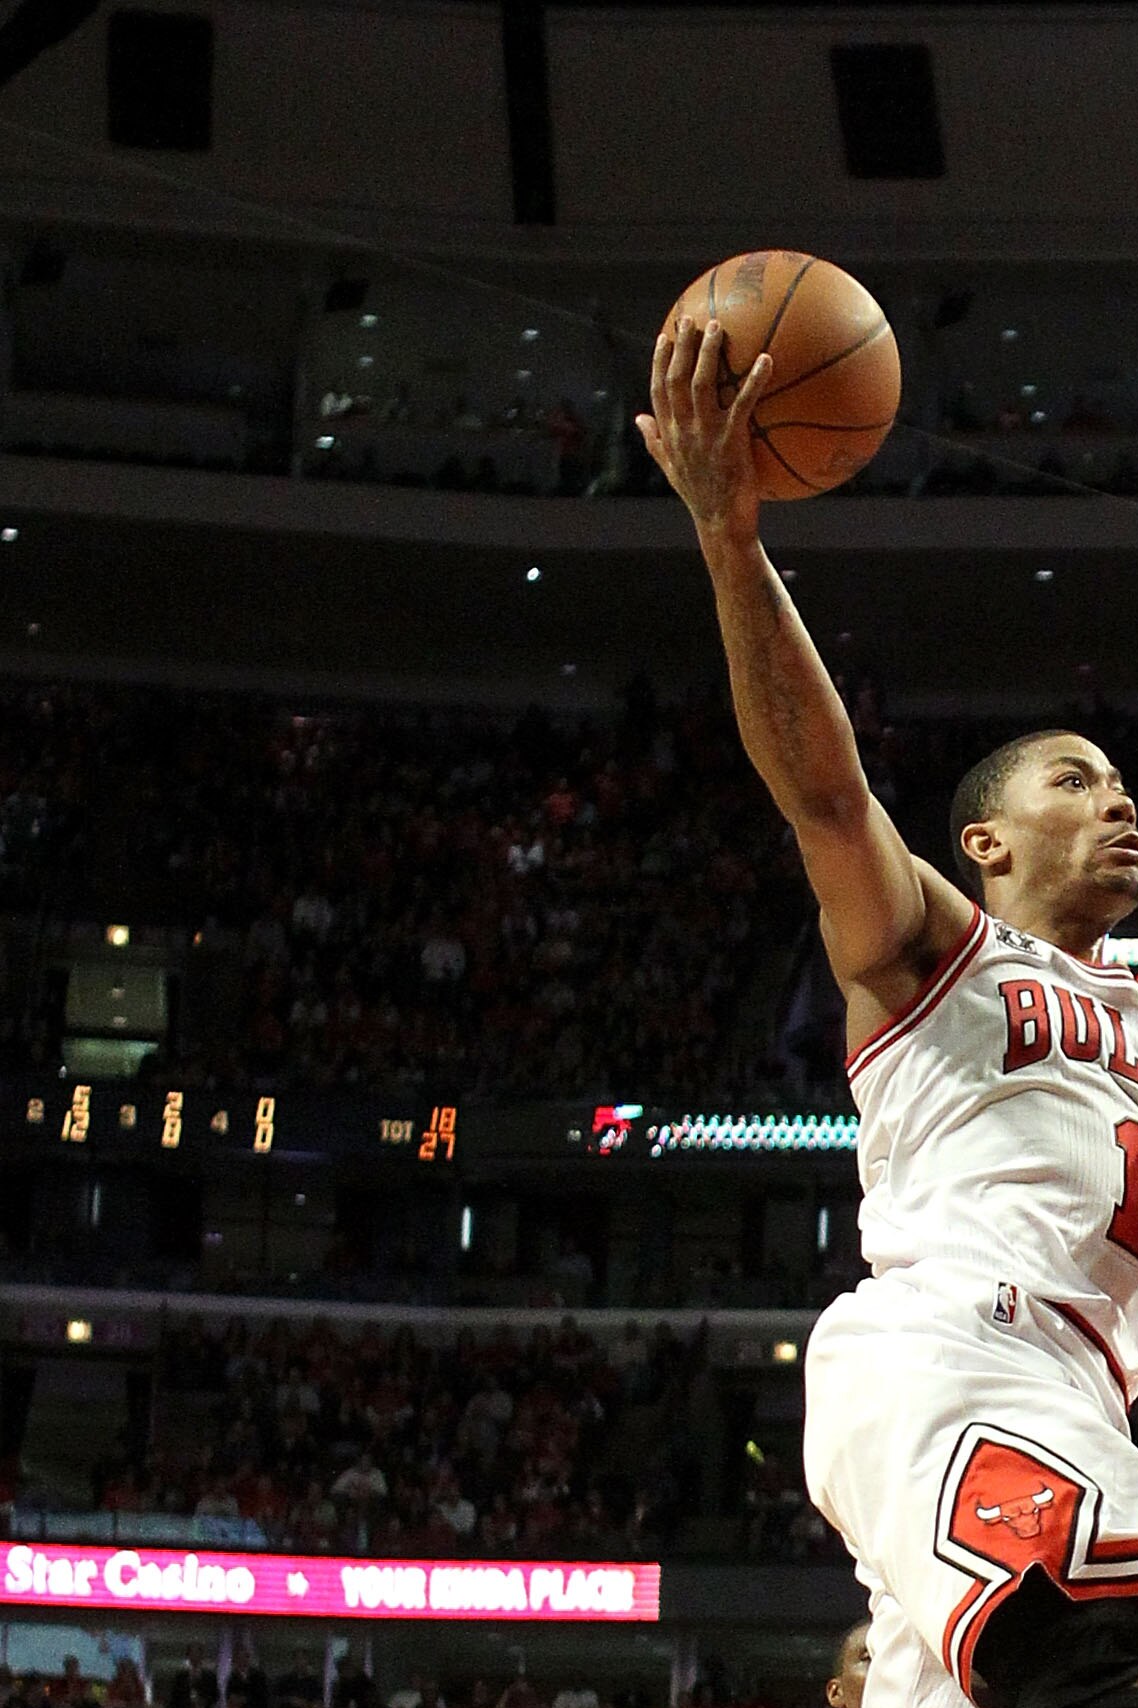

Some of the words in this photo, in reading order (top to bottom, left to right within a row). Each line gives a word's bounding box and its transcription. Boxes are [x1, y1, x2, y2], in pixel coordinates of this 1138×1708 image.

[429, 1106, 457, 1132] 18
[418, 1131, 456, 1160] 27
[5, 1545, 98, 1595] Star
[103, 1550, 256, 1603] Casino
[341, 1566, 427, 1609] YOUR
